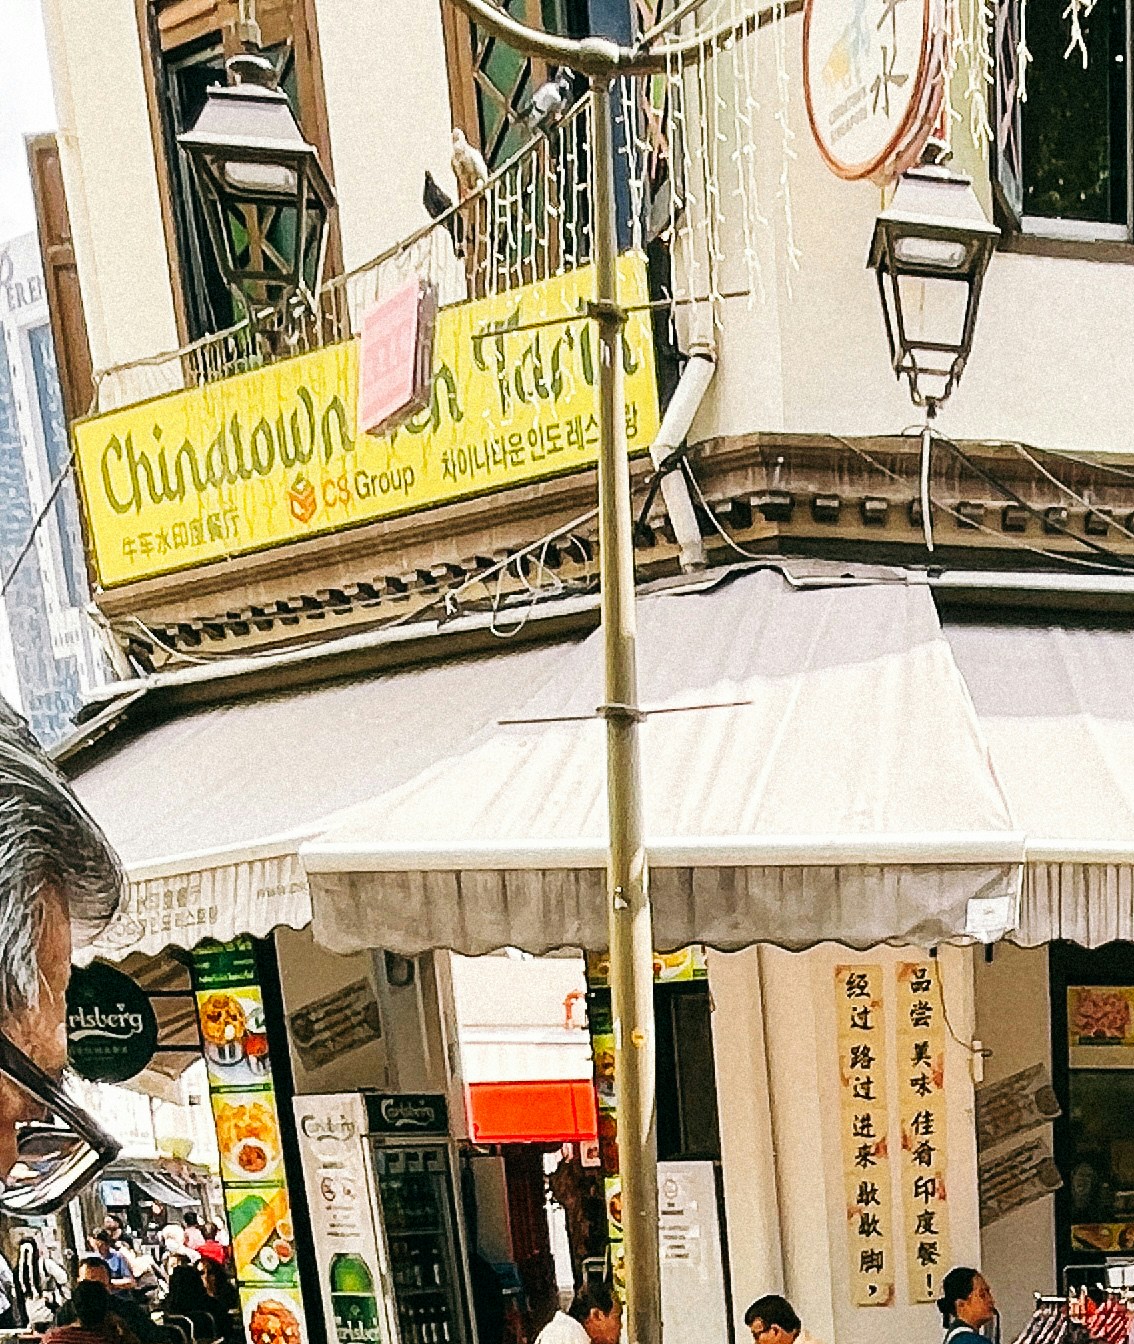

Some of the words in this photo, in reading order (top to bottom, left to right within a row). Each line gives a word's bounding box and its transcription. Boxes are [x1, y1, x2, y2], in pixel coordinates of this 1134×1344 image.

[100, 386, 355, 513] Chinatown
[322, 474, 350, 508] CS
[355, 465, 415, 499] Group
[69, 1004, 143, 1033] rlsberg
